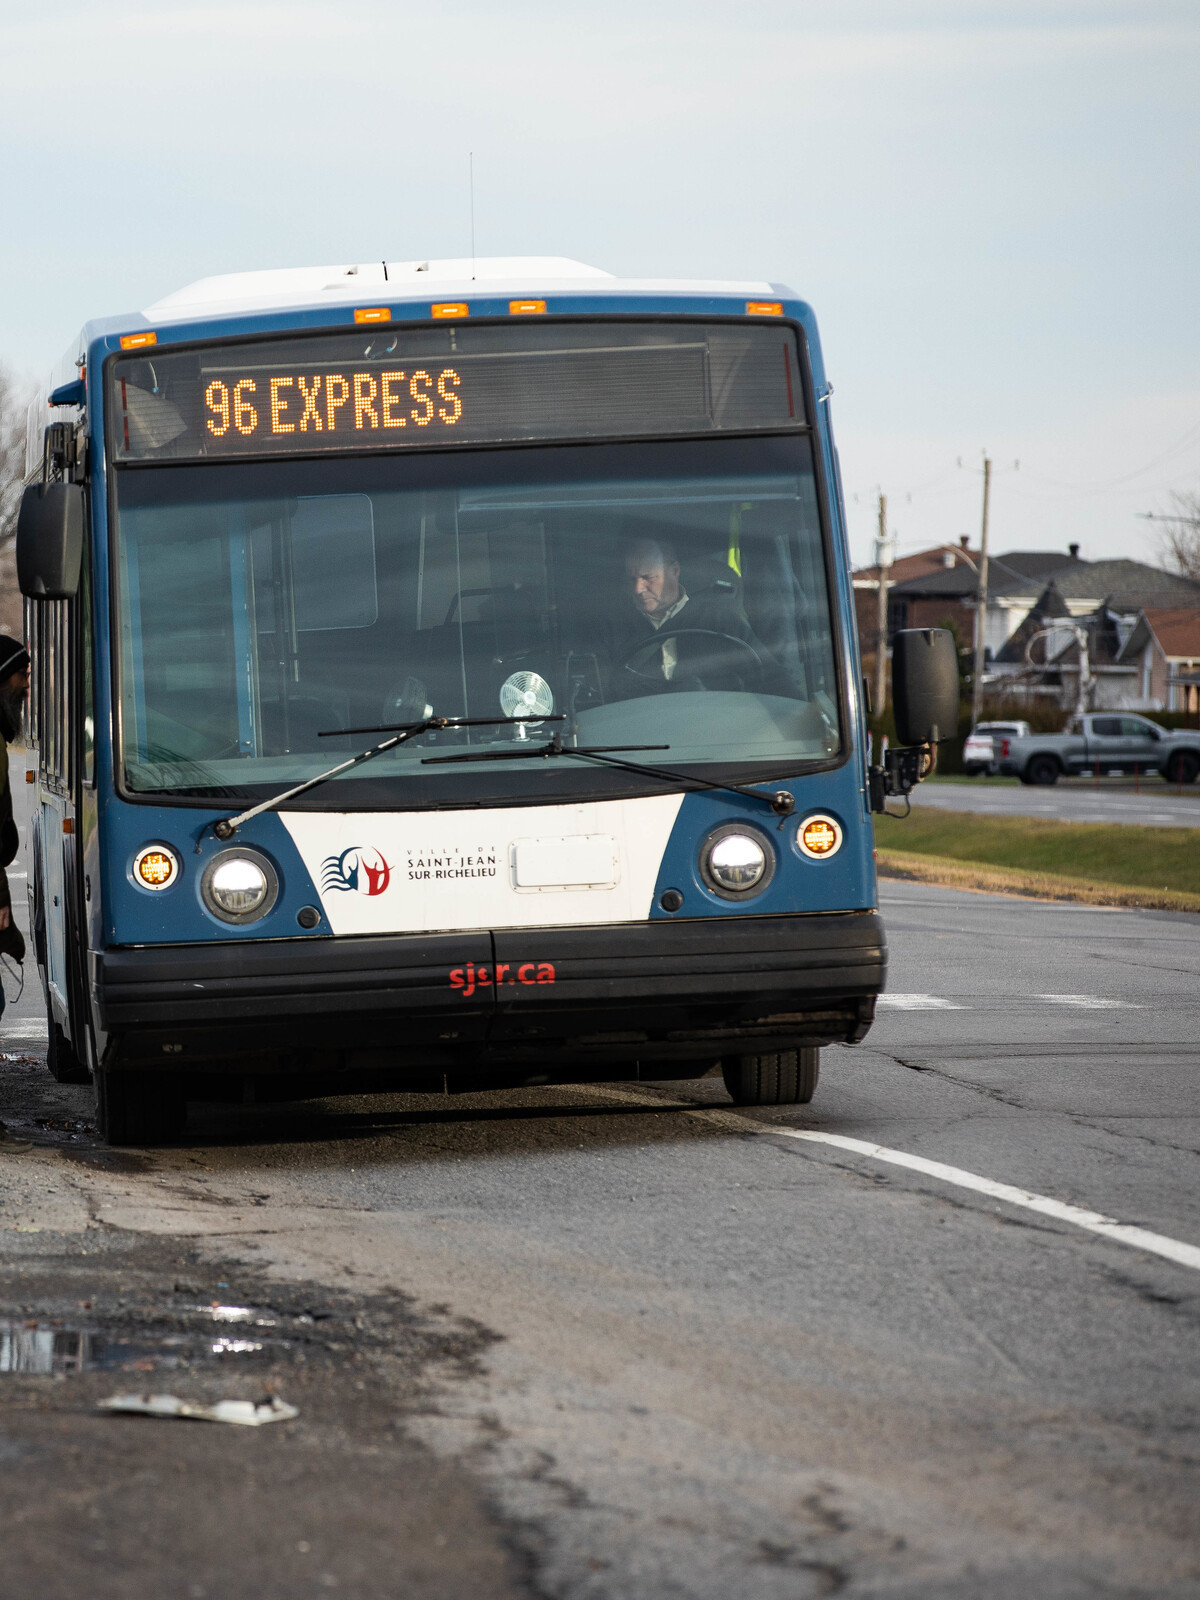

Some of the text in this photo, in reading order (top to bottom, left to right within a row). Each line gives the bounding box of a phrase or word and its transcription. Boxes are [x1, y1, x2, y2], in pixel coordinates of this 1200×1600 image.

[205, 368, 462, 436] 96 EXPRESS
[408, 868, 496, 880] SUR-RICHELIEU
